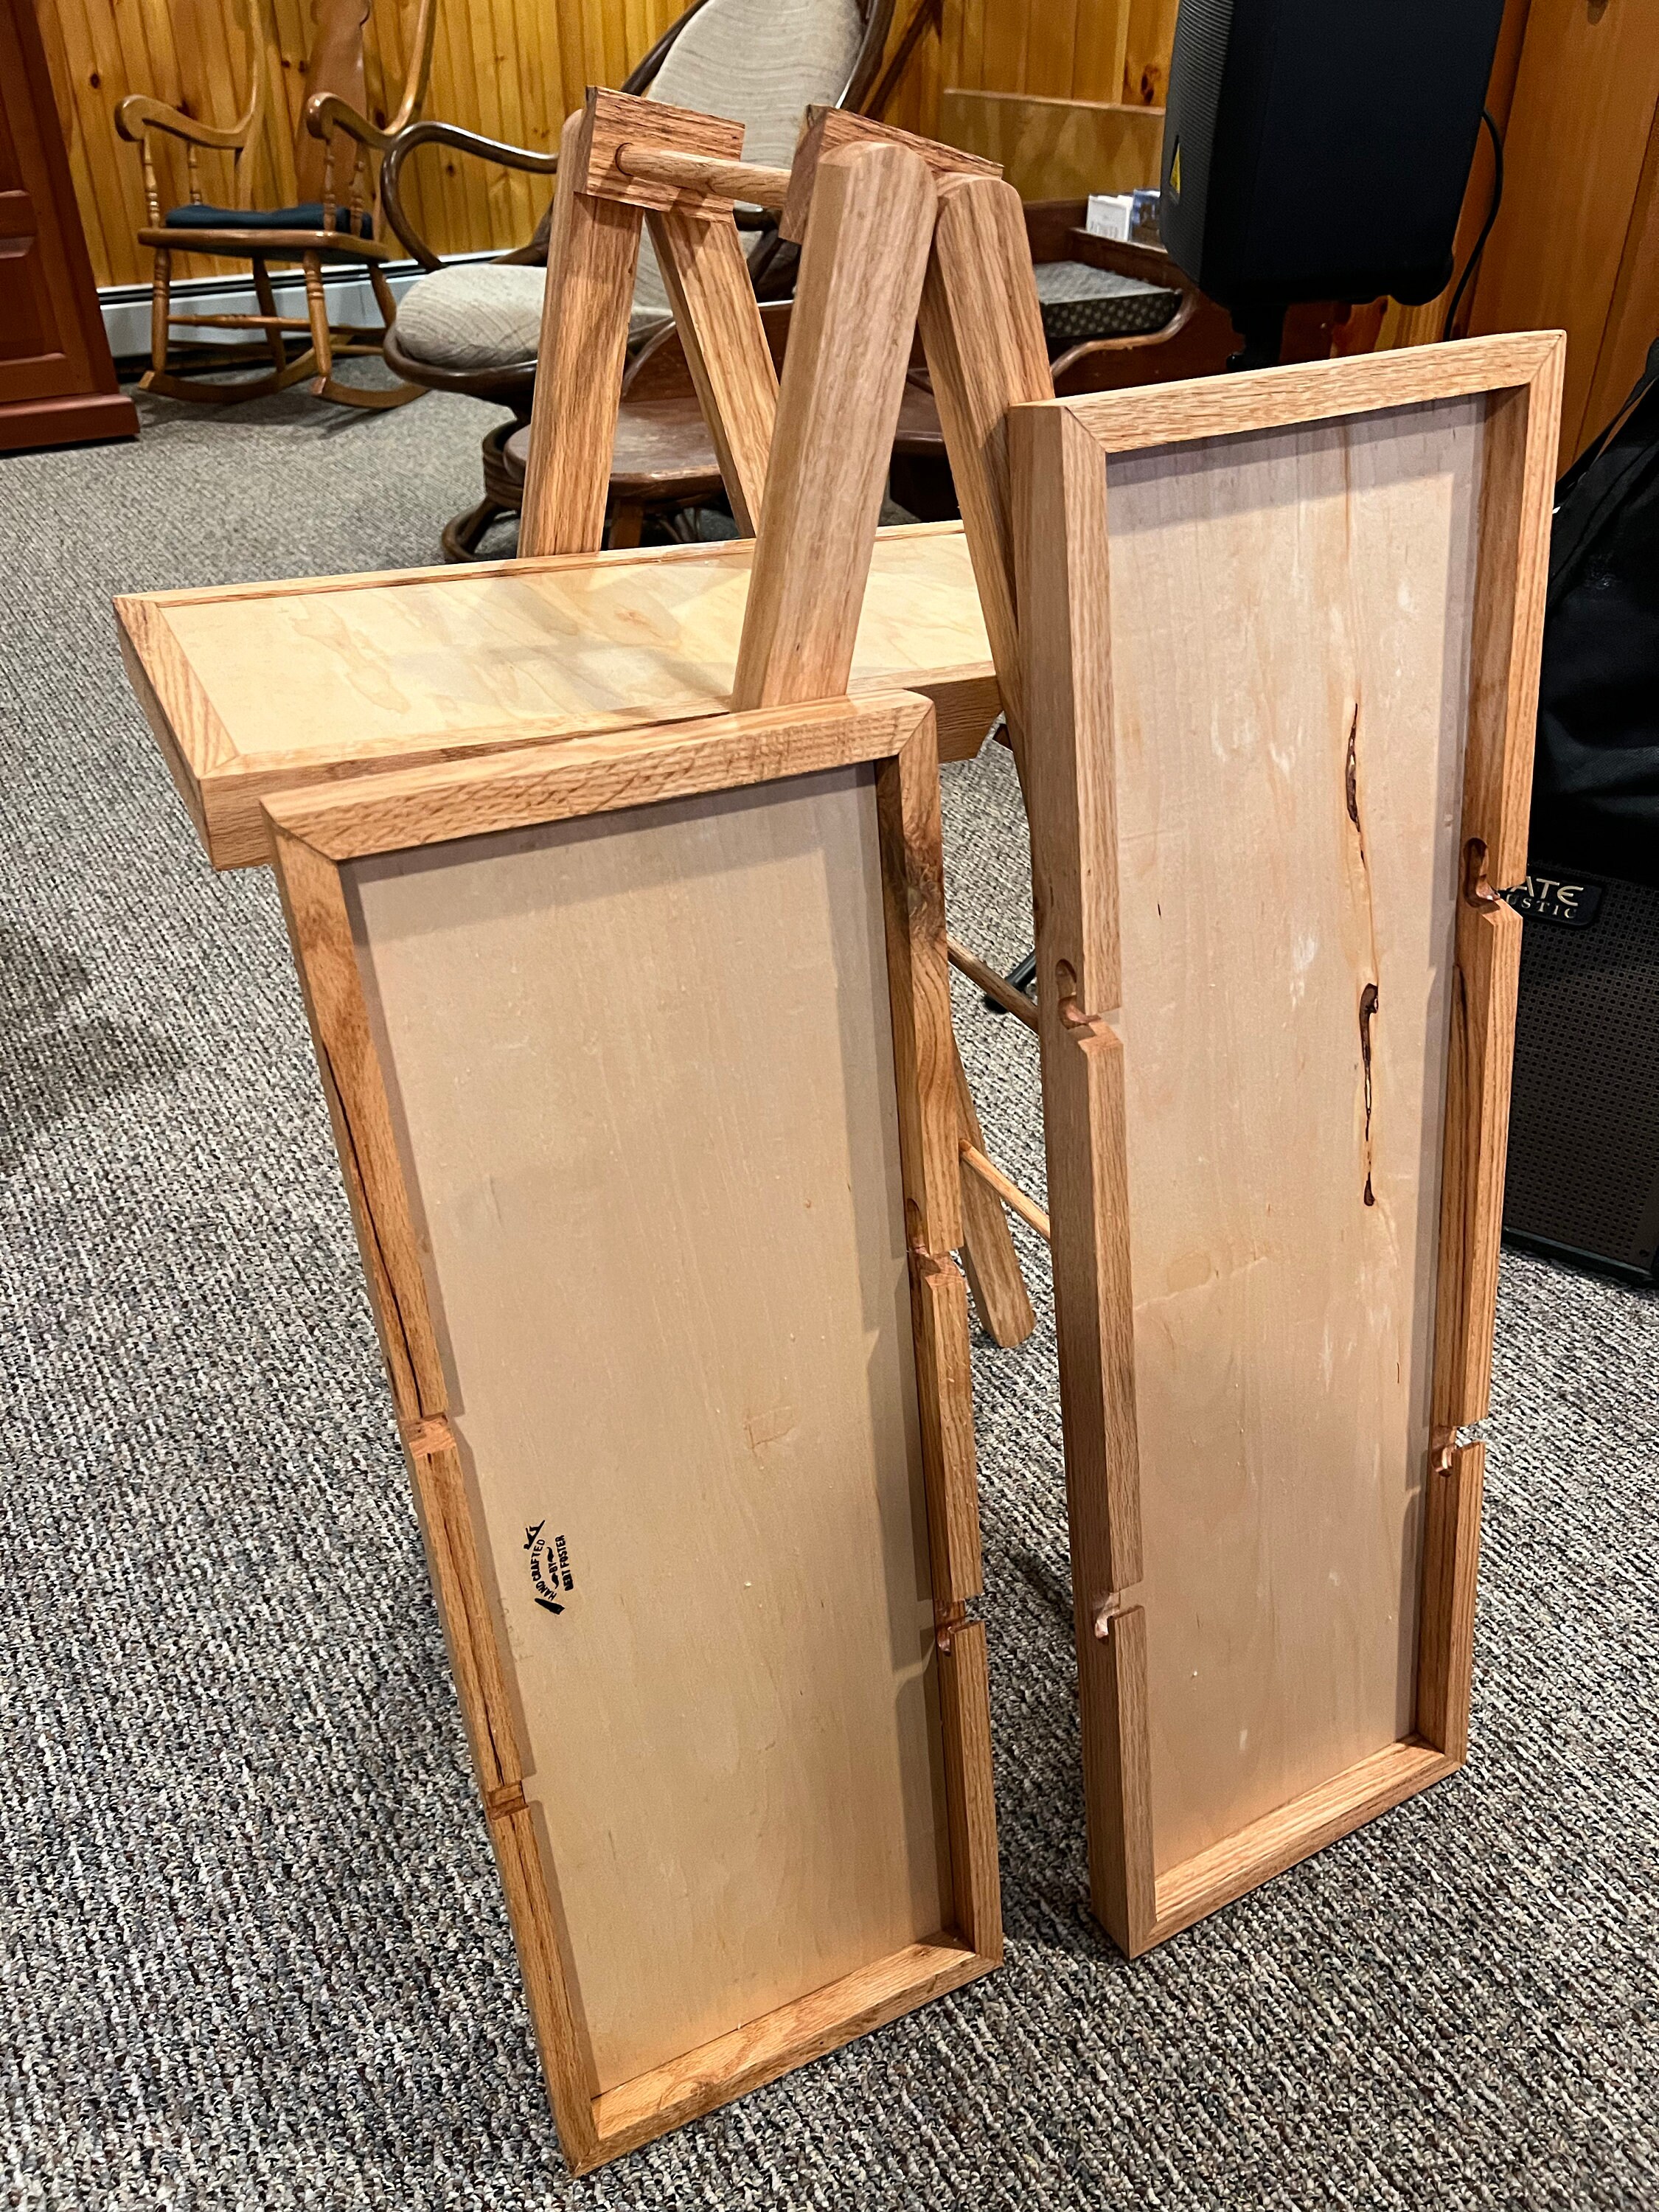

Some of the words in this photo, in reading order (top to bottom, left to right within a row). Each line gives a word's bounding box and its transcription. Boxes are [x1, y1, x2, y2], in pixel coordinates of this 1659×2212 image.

[1509, 876, 1584, 907] ATE
[1506, 894, 1576, 919] USTIC
[530, 1539, 545, 1582] CRAFTED
[555, 1535, 569, 1568] FOSTER
[548, 1562, 558, 1573] BY
[536, 1581, 557, 1601] HAND
